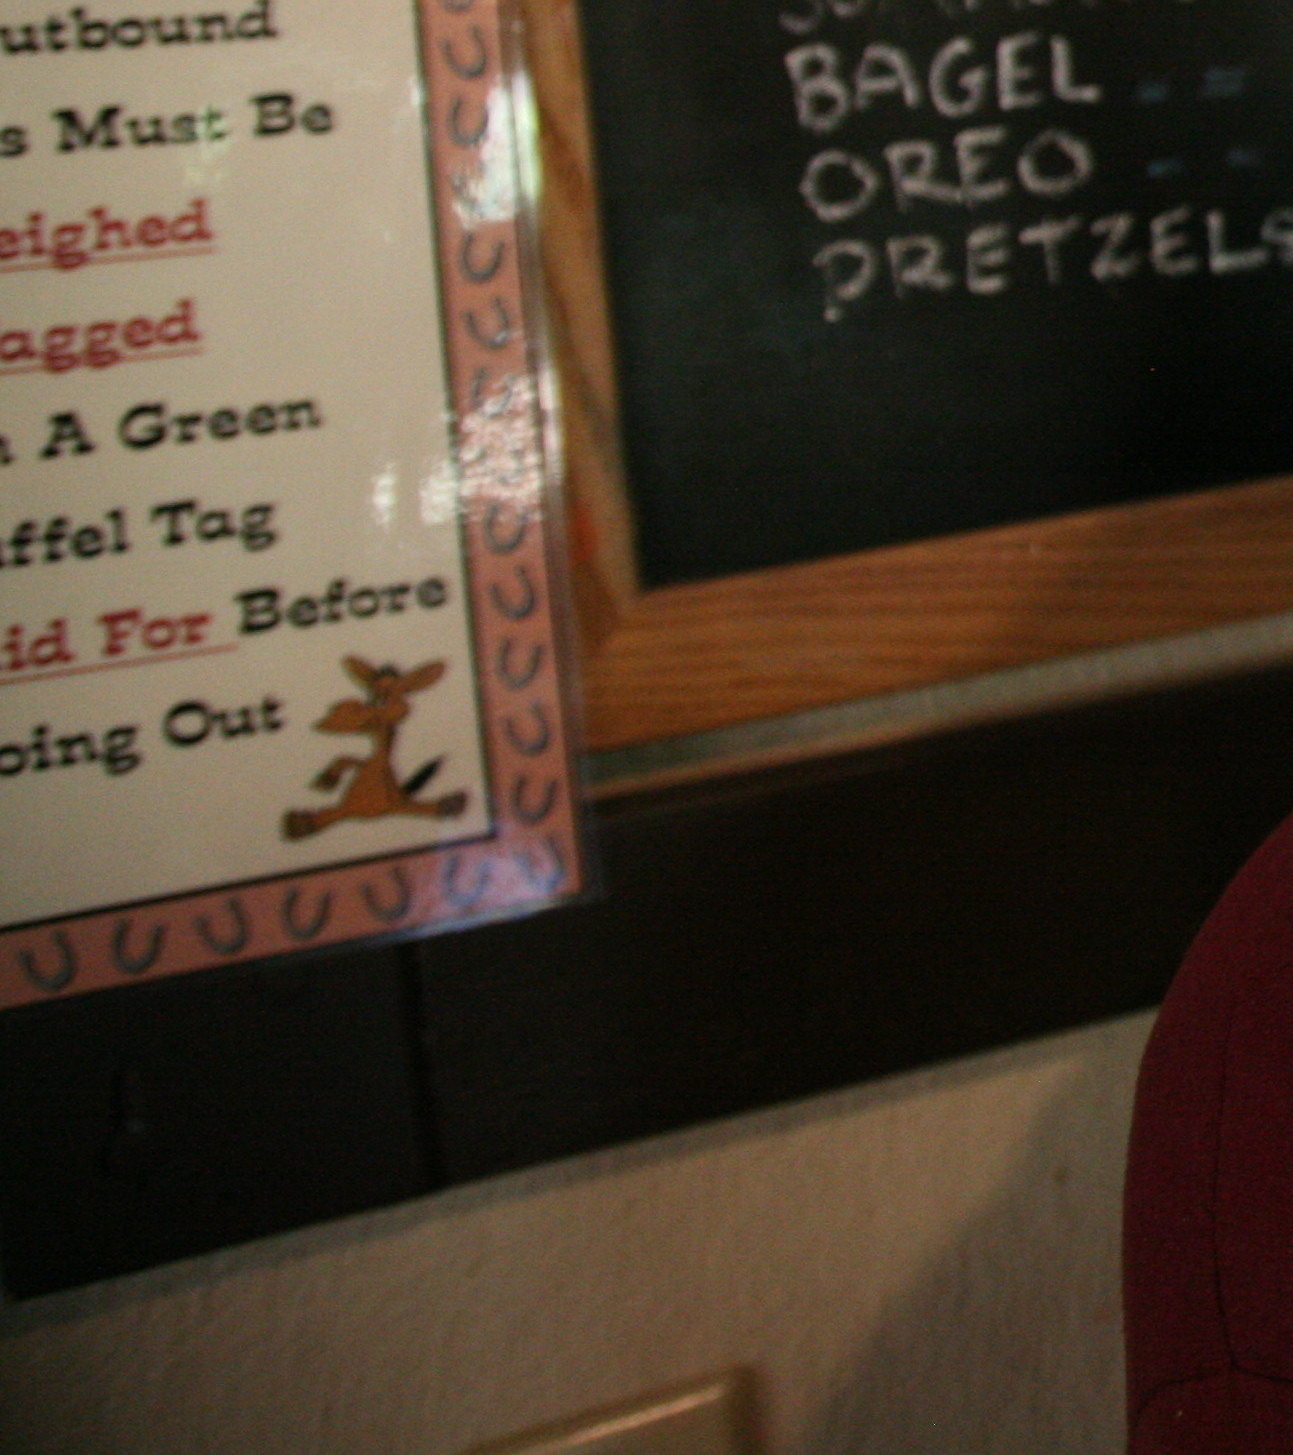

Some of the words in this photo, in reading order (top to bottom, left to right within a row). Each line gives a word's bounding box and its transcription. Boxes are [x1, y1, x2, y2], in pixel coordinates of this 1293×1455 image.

[783, 34, 1102, 133] BAGEL
[52, 103, 230, 154] Must
[250, 91, 335, 139] Be
[800, 126, 1094, 222] OREO
[39, 409, 96, 460] A
[117, 397, 324, 450] Green
[0, 508, 131, 568] ffel
[150, 499, 280, 553] Tag
[97, 608, 213, 658] For
[234, 576, 449, 637] Before
[163, 696, 286, 748] Out
